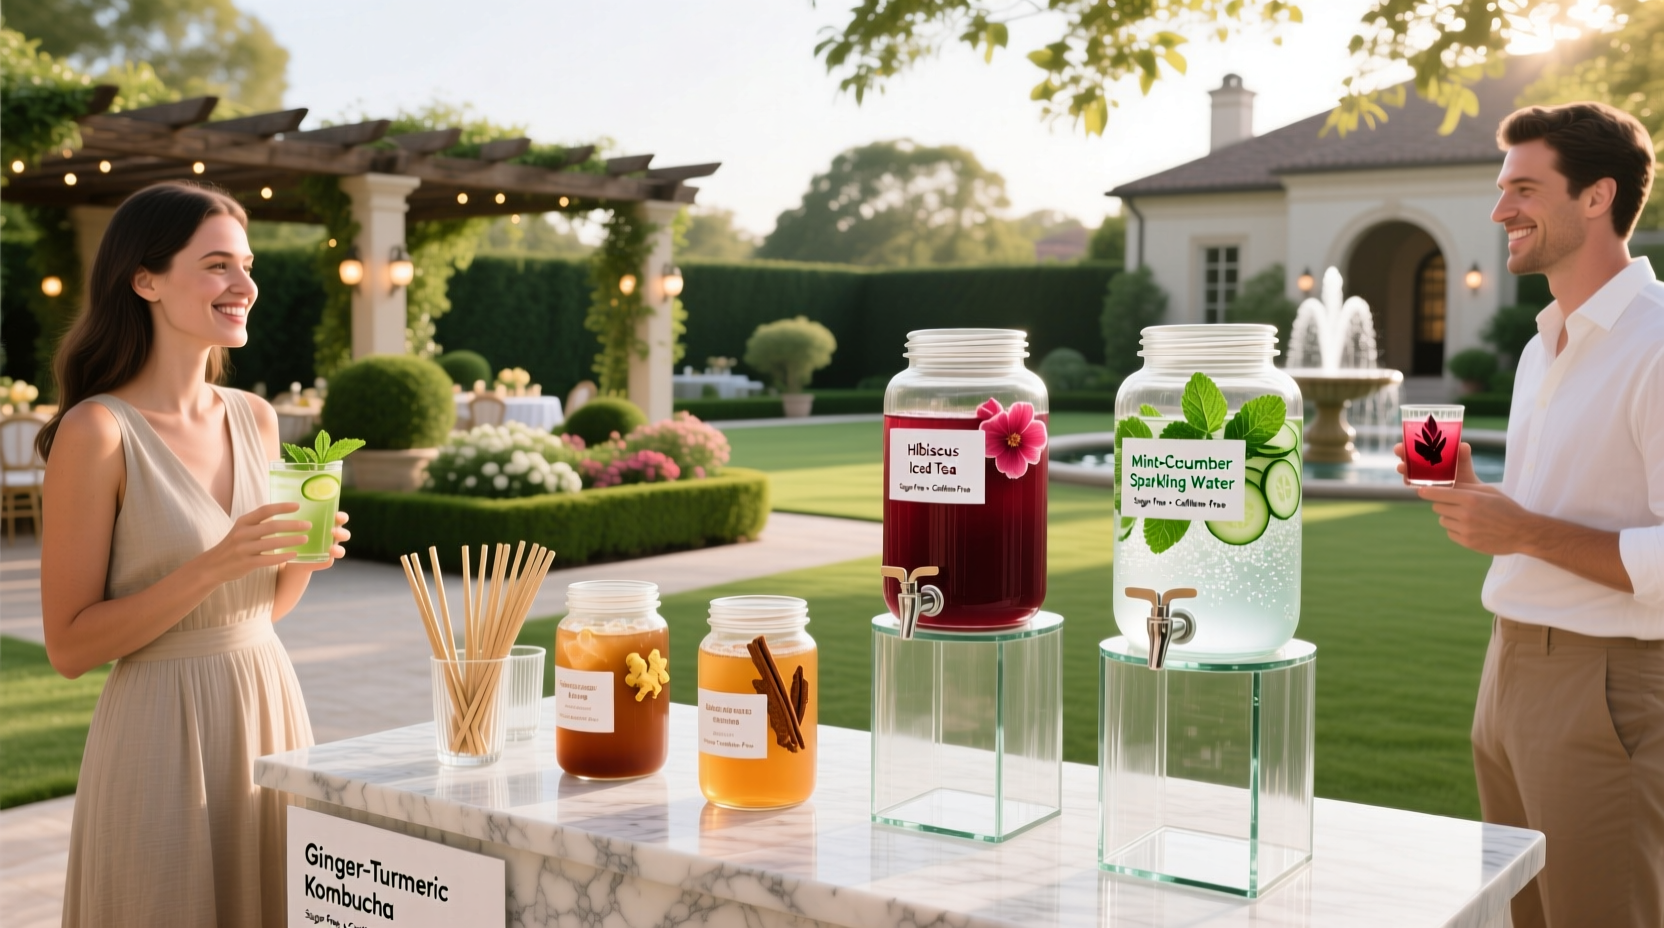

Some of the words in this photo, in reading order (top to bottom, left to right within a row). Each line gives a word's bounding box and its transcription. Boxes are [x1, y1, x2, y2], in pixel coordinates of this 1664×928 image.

[909, 461, 931, 475] Iced
[934, 462, 957, 475] Tea
[1130, 473, 1186, 493] Sparkling
[1191, 475, 1235, 490] Water
[305, 842, 449, 902] Ginger-Turmeric
[305, 874, 394, 920] Kombucha
